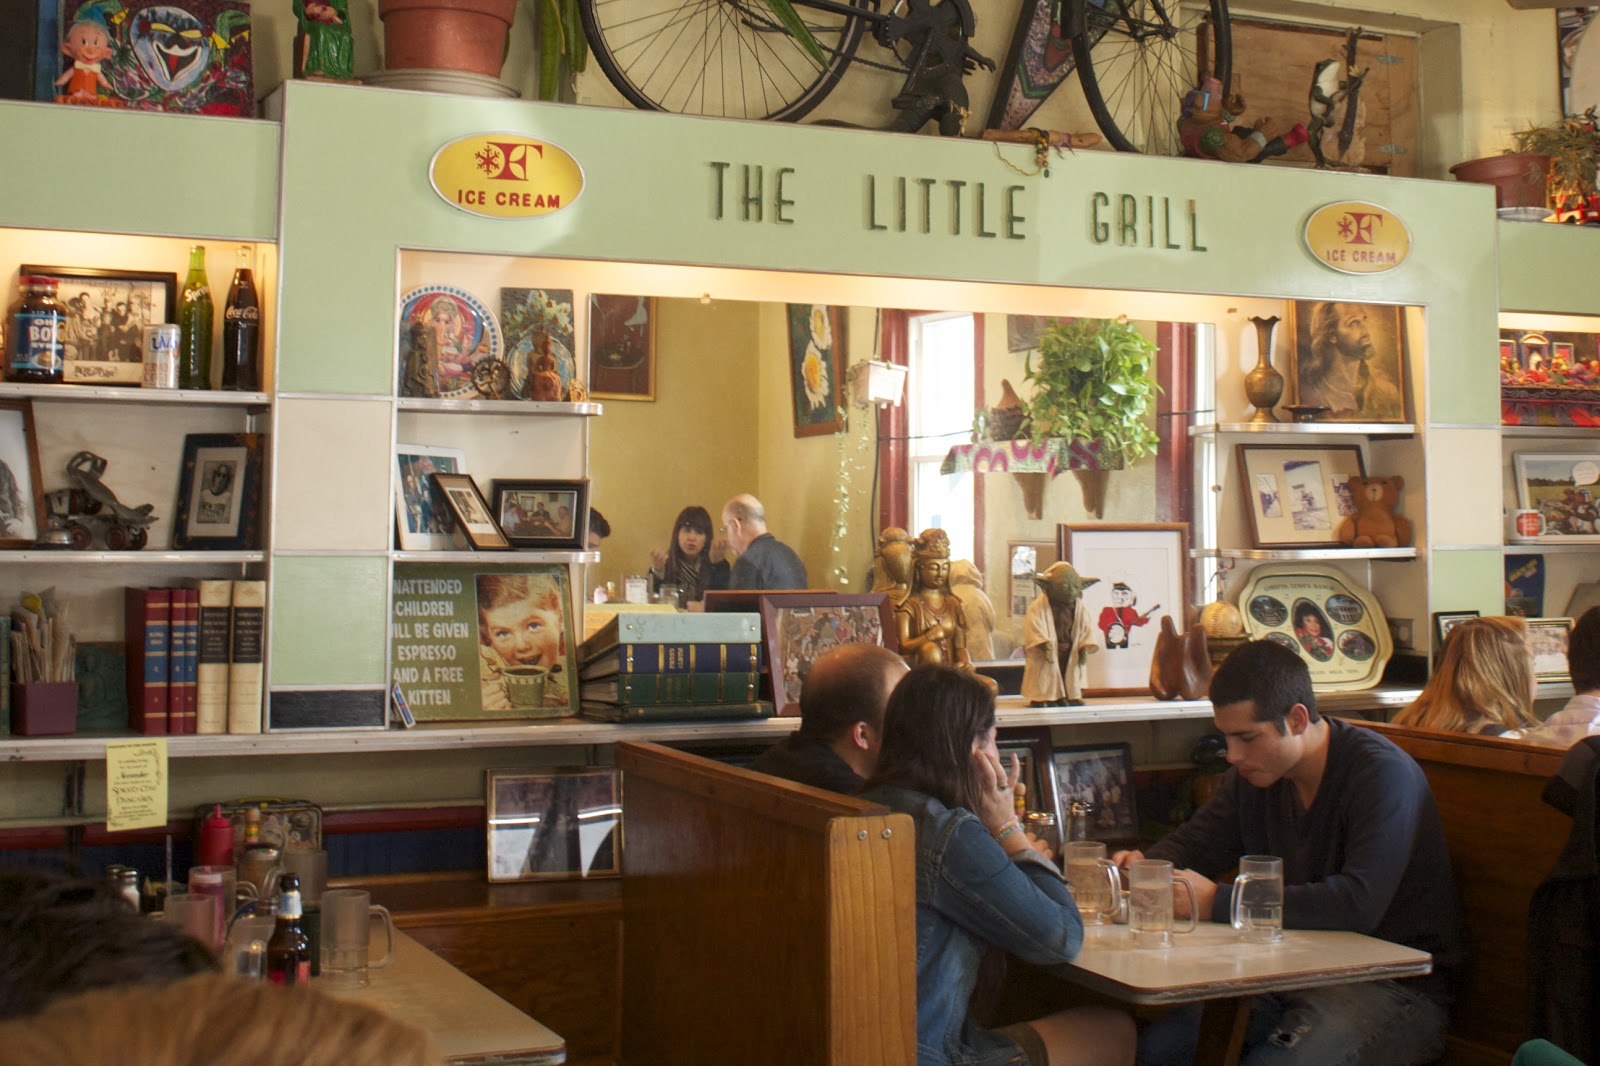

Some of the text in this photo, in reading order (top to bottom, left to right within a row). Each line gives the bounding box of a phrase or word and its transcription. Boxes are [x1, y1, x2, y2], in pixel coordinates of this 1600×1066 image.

[457, 189, 560, 209] ICE CREAM
[710, 161, 1208, 252] THE LITTLE GRILL
[1326, 249, 1396, 264] ICE CREAM
[393, 579, 462, 594] NATTENDED
[395, 601, 455, 617] CHILDREN
[391, 622, 469, 639] ILL BE GIVEN
[397, 644, 456, 662] ESPRESSO
[393, 667, 465, 683] AND A FREE
[408, 689, 451, 706] KITTEN
